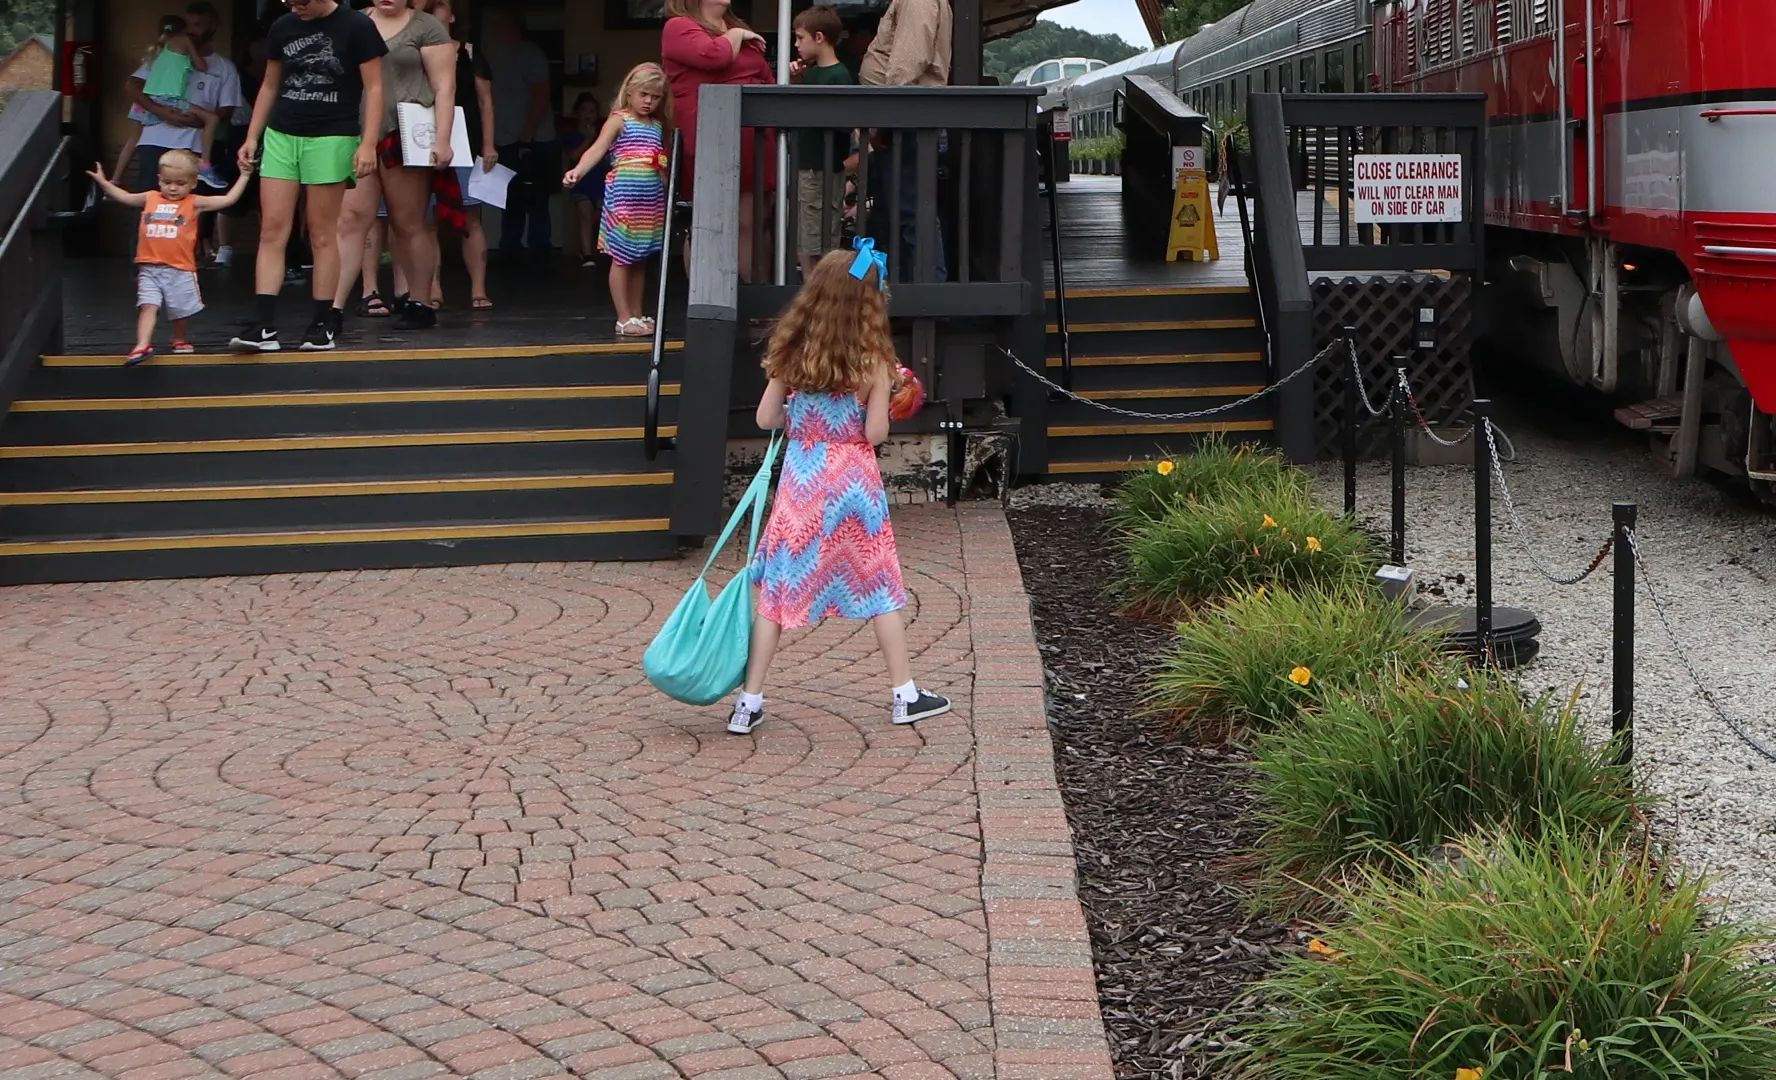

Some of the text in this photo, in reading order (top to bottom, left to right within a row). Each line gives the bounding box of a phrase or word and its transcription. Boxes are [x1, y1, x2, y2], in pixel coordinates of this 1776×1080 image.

[1357, 161, 1459, 180] CLOSE CLEARANCE
[1358, 185, 1459, 200] WILL NOT CLEAR MAN
[1371, 201, 1445, 215] ON SIDE OF CAR
